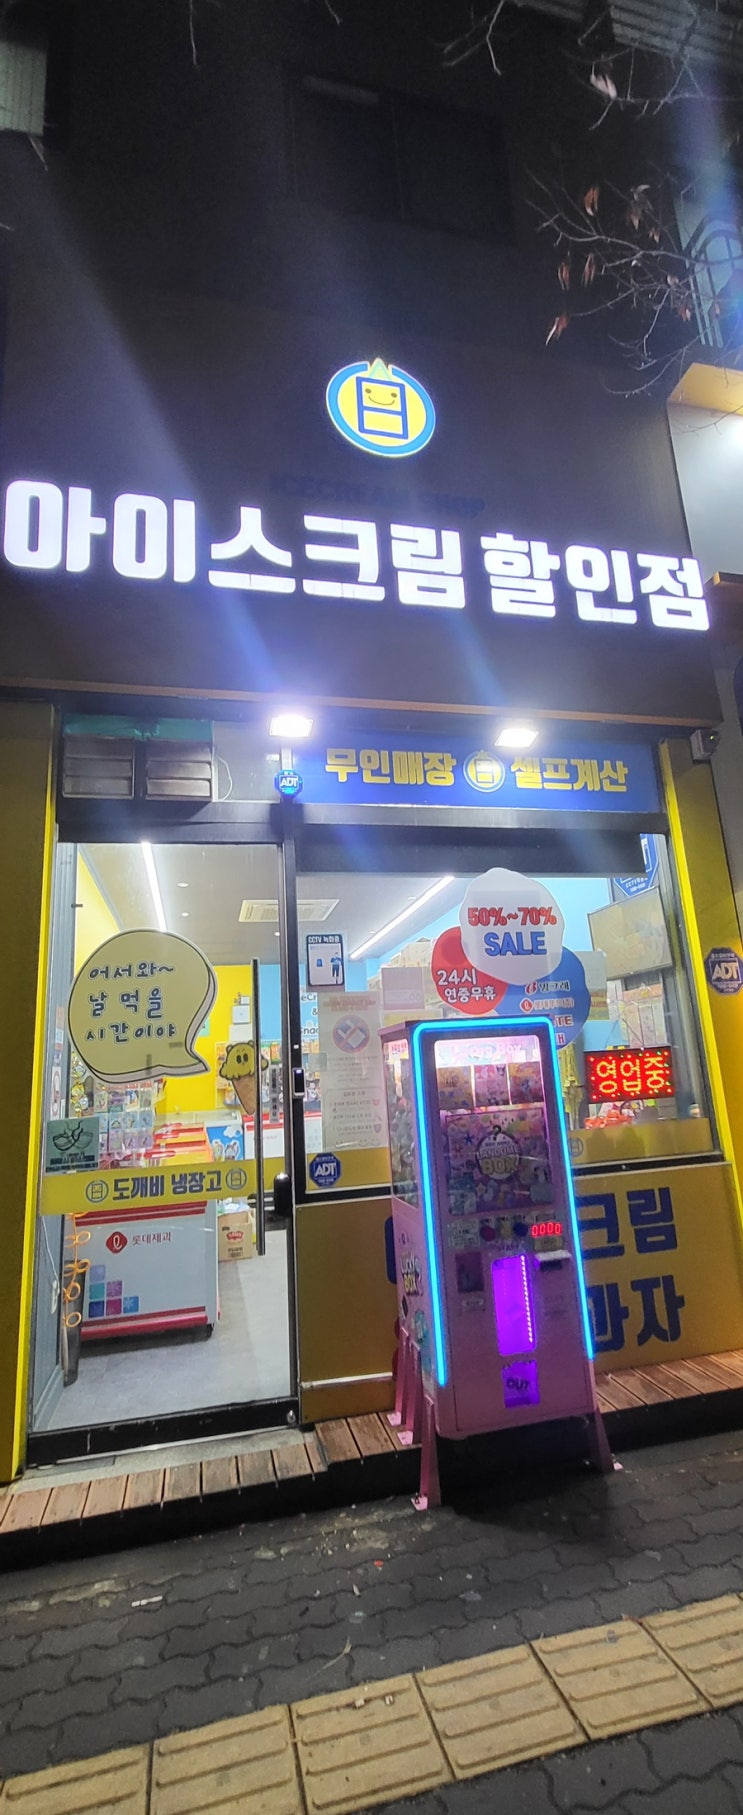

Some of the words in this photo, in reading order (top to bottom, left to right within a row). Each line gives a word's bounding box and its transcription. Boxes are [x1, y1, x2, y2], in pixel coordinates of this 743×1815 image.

[3, 479, 466, 609] 아이스크림
[480, 531, 710, 632] 할인점
[325, 748, 457, 786] 무인매장
[510, 754, 628, 792] 셀프계산
[280, 777, 298, 787] ADT
[467, 906, 557, 927] 50%~70%
[308, 935, 322, 943] CCTV
[484, 931, 547, 957] SALE
[89, 962, 174, 979] 어서와~
[436, 968, 477, 986] 24시
[712, 962, 738, 980] ADT
[89, 991, 107, 1017] 날
[444, 985, 496, 1003] 연중무휴
[86, 1022, 176, 1043] 시간이야
[596, 1056, 665, 1094] 영업중
[314, 1162, 336, 1177] ADT
[112, 1175, 165, 1201] 도깨비
[171, 1170, 222, 1195] 냉장고
